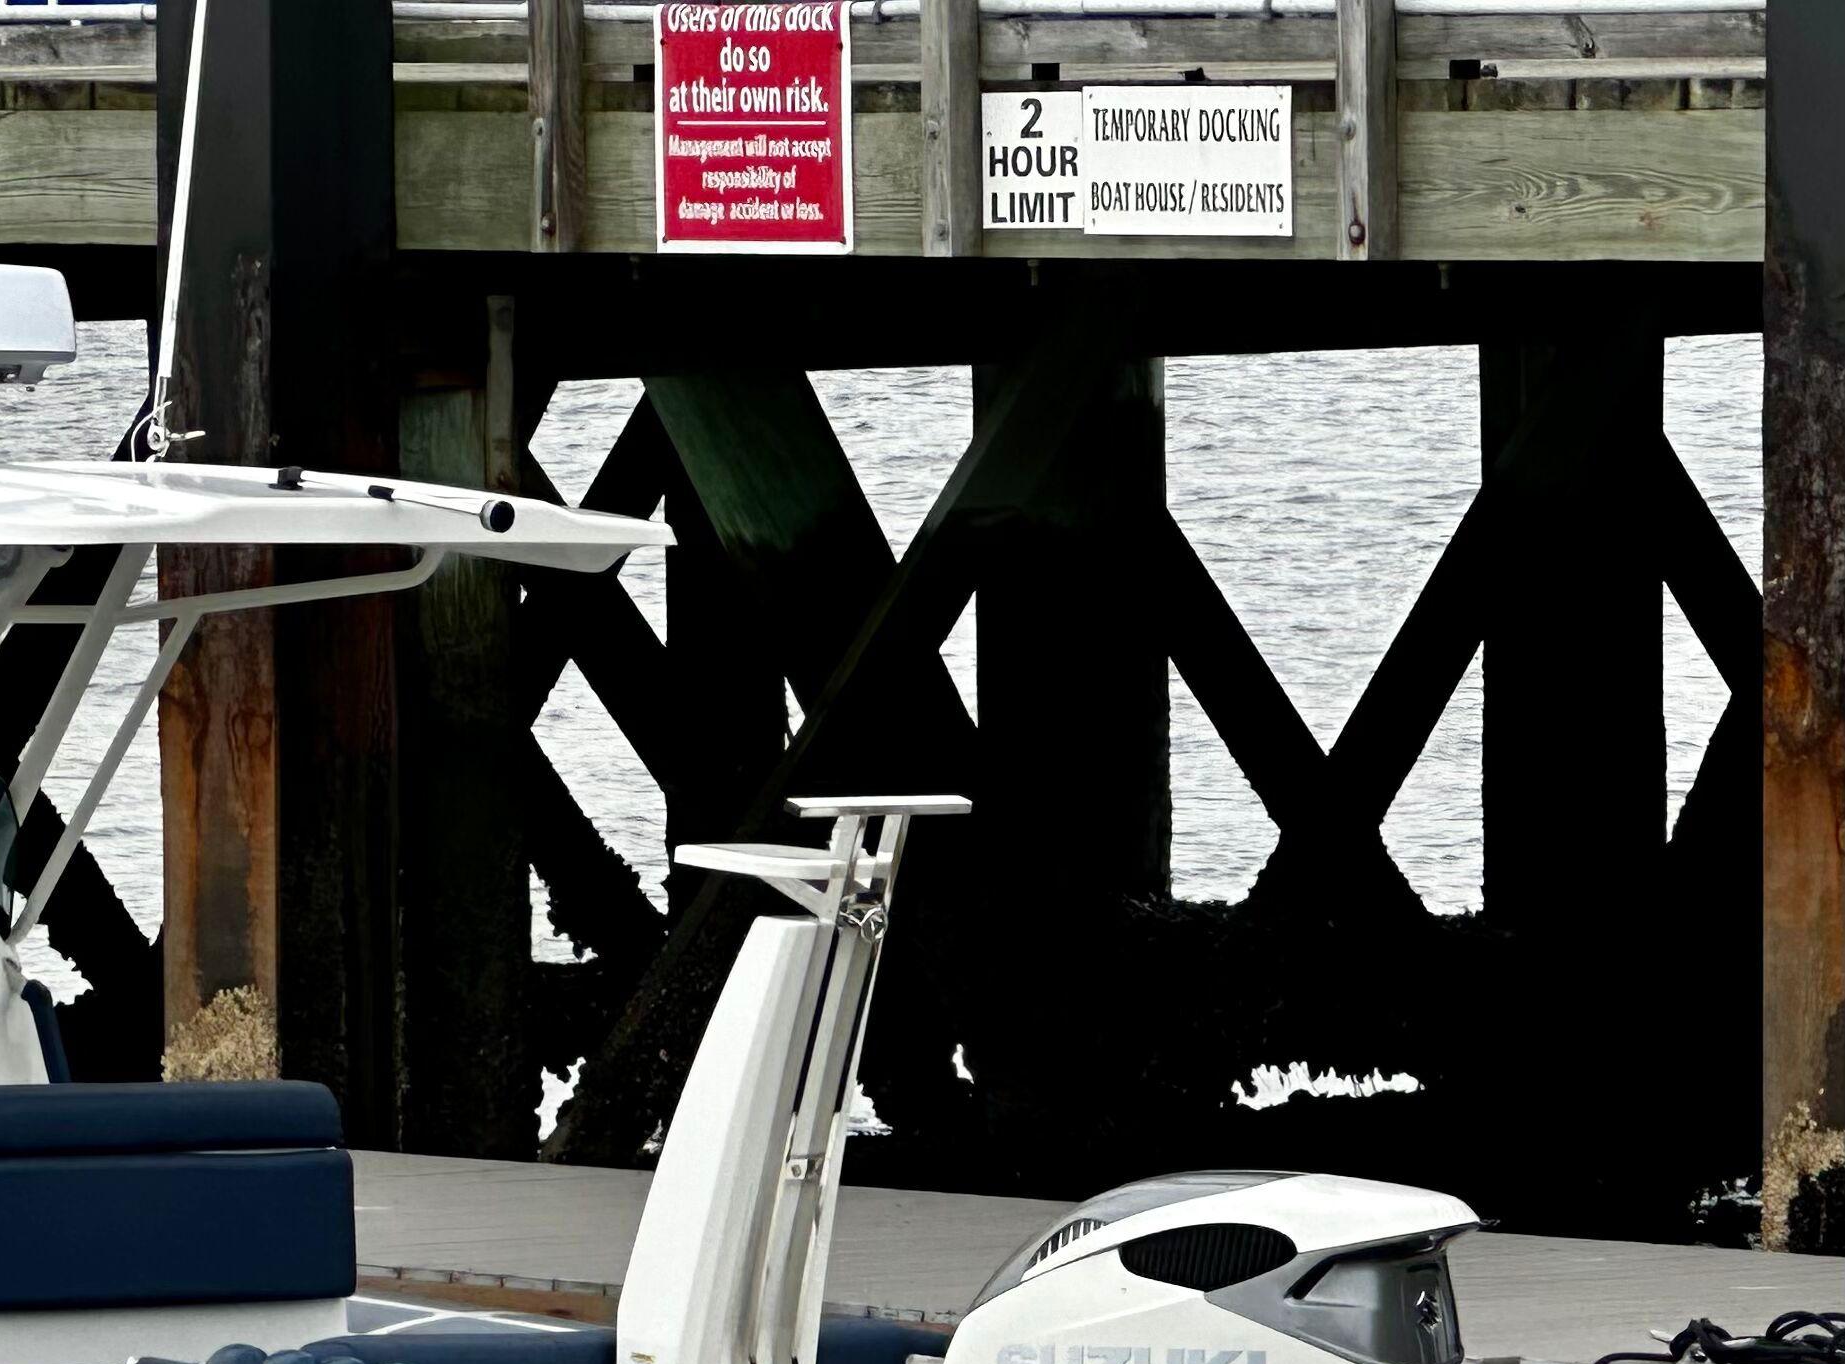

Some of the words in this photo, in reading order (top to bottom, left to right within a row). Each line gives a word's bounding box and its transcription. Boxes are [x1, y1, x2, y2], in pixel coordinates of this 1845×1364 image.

[667, 3, 719, 32] Users
[719, 36, 744, 72] do
[748, 46, 771, 72] so
[669, 80, 688, 113] at
[691, 76, 736, 113] their
[740, 85, 781, 113] own
[786, 76, 829, 113] risk.
[1020, 98, 1043, 138] 2
[1092, 108, 1190, 142] TEMPORARY
[1199, 108, 1280, 142] DOCKING
[668, 135, 744, 163] Management
[745, 134, 767, 157] will
[768, 138, 790, 157] not
[792, 138, 832, 162] accept
[989, 146, 1078, 177] HOUR
[702, 166, 781, 194] responsibility
[991, 192, 1076, 223] LIMIT
[1201, 182, 1285, 213] RESIDENTS
